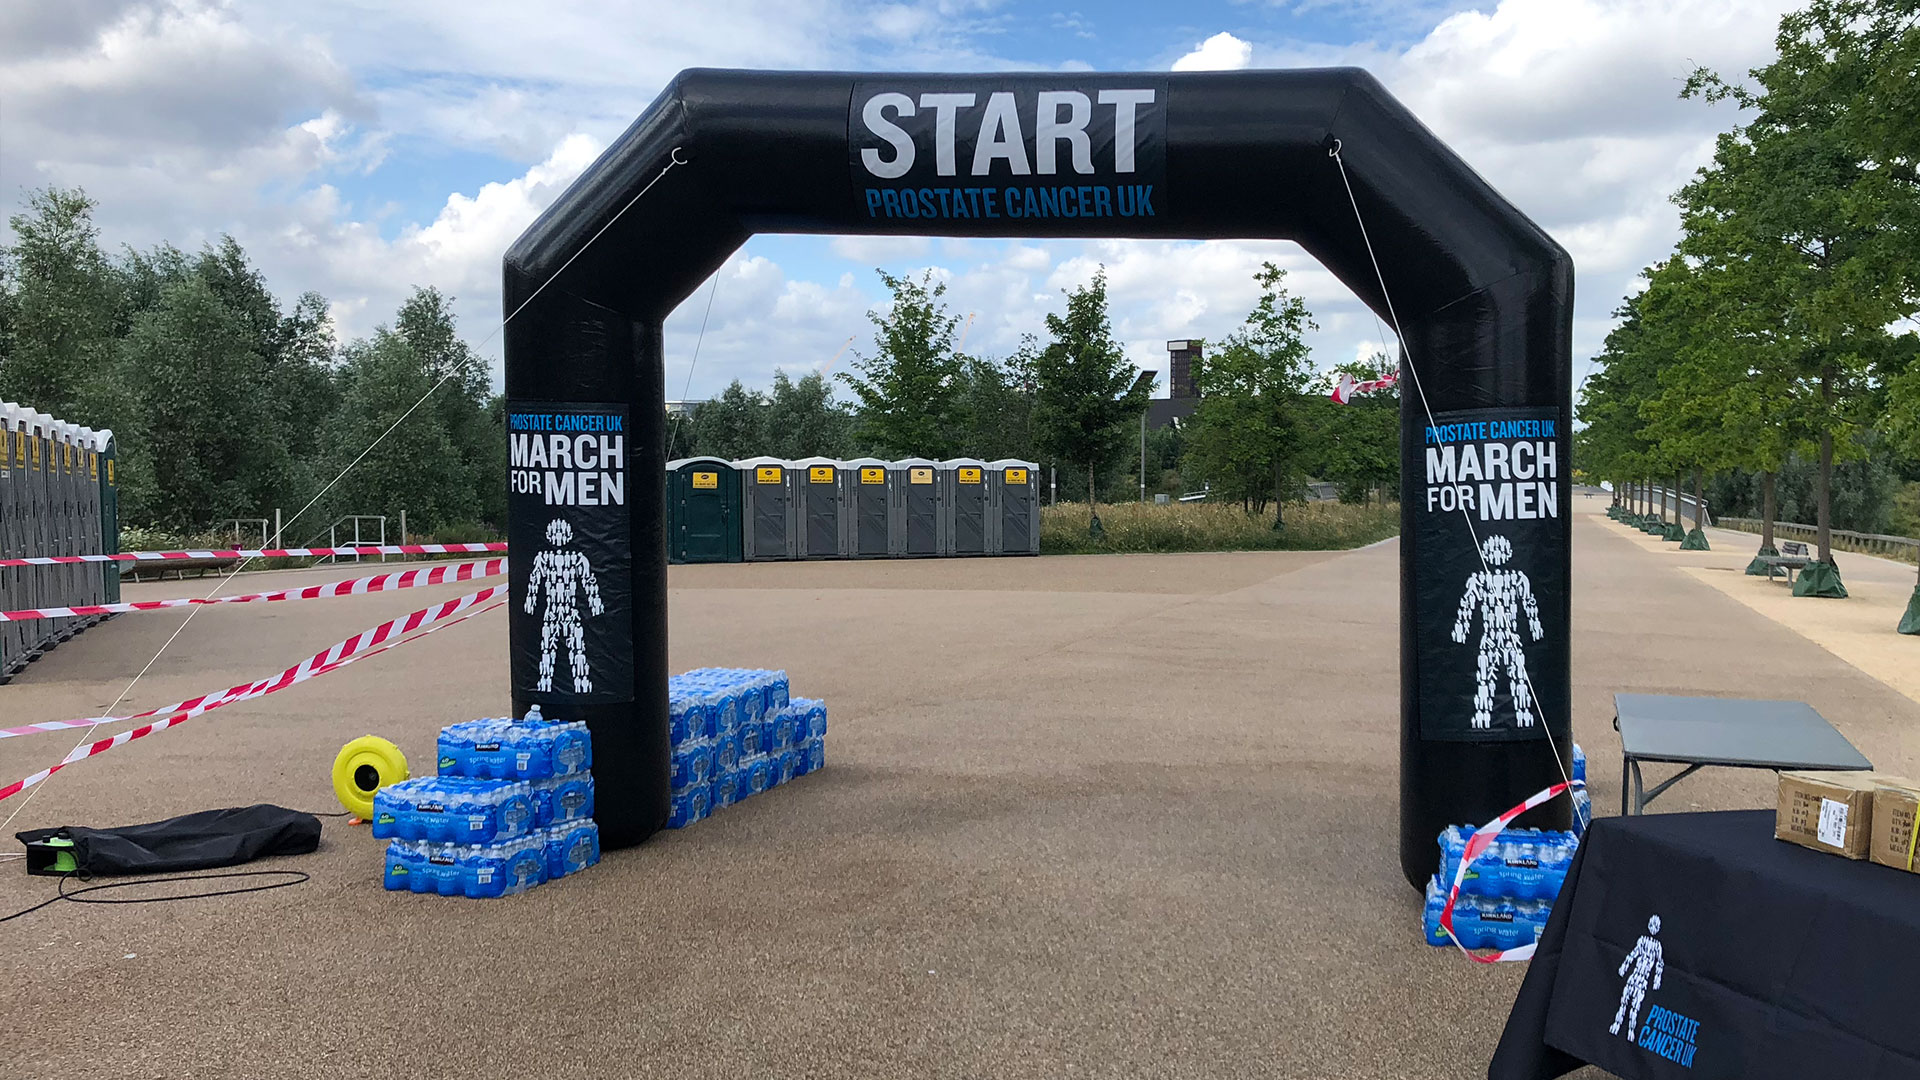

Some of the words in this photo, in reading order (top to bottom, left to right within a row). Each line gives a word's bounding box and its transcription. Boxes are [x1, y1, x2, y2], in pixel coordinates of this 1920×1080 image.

[860, 88, 1155, 179] START
[865, 187, 1001, 218] PROSTATE
[1006, 185, 1114, 218] CANCER
[1117, 184, 1156, 217] UK
[510, 414, 552, 430] PROSTATE
[555, 415, 605, 431] CANCER
[606, 415, 623, 431] UK
[1425, 422, 1487, 444] PROSTATE
[1490, 420, 1540, 439] CANCER
[1541, 420, 1556, 437] UK
[510, 433, 624, 469] MARCH
[1426, 441, 1557, 484] MARCH
[511, 470, 542, 494] FOR
[545, 471, 624, 505] MEN
[1427, 485, 1476, 512] FOR
[1479, 482, 1557, 521] MEN
[1499, 871, 1522, 880] spring
[1523, 873, 1545, 881] water
[1474, 926, 1497, 935] spring
[1498, 928, 1519, 937] water
[1645, 1004, 1700, 1044] PROSTATE
[1638, 1025, 1683, 1064] CANCER
[1681, 1043, 1698, 1069] UK
